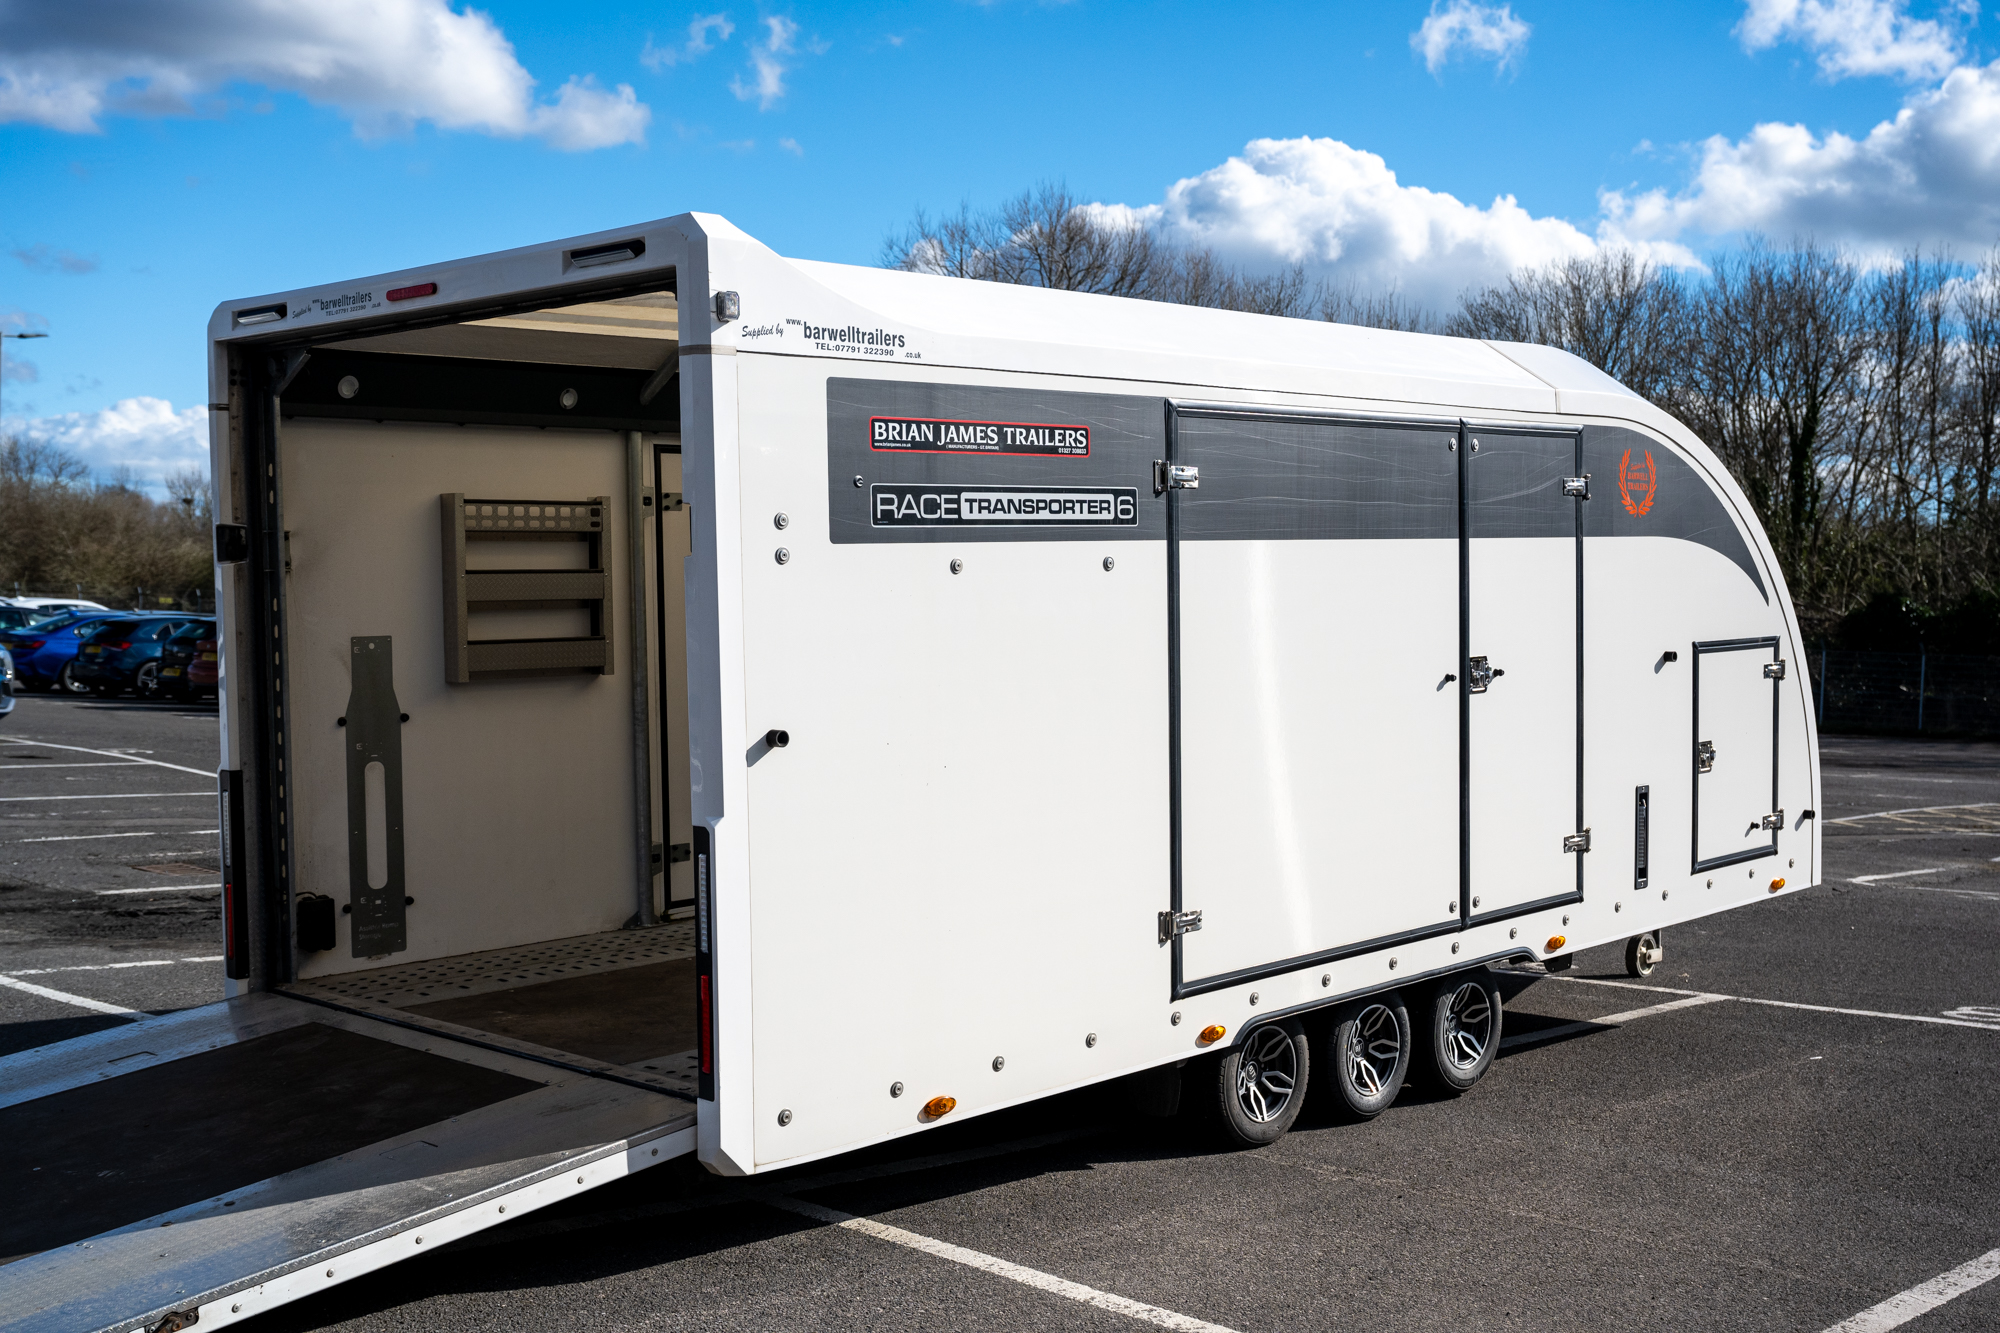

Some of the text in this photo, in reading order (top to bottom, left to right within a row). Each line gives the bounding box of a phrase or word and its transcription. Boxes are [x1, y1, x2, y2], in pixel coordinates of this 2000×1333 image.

[320, 292, 372, 311] barwelltrailers
[326, 309, 349, 317] TEL:07791
[742, 325, 774, 339] Supplied
[775, 324, 784, 337] by
[786, 318, 803, 326] www.
[803, 321, 906, 348] barwelltrailers
[815, 342, 895, 357] TEL:07791 322390
[874, 422, 1087, 448] BRIAN JAMES TRAILERS
[877, 493, 1135, 519] RACE TRANSPORTER 6
